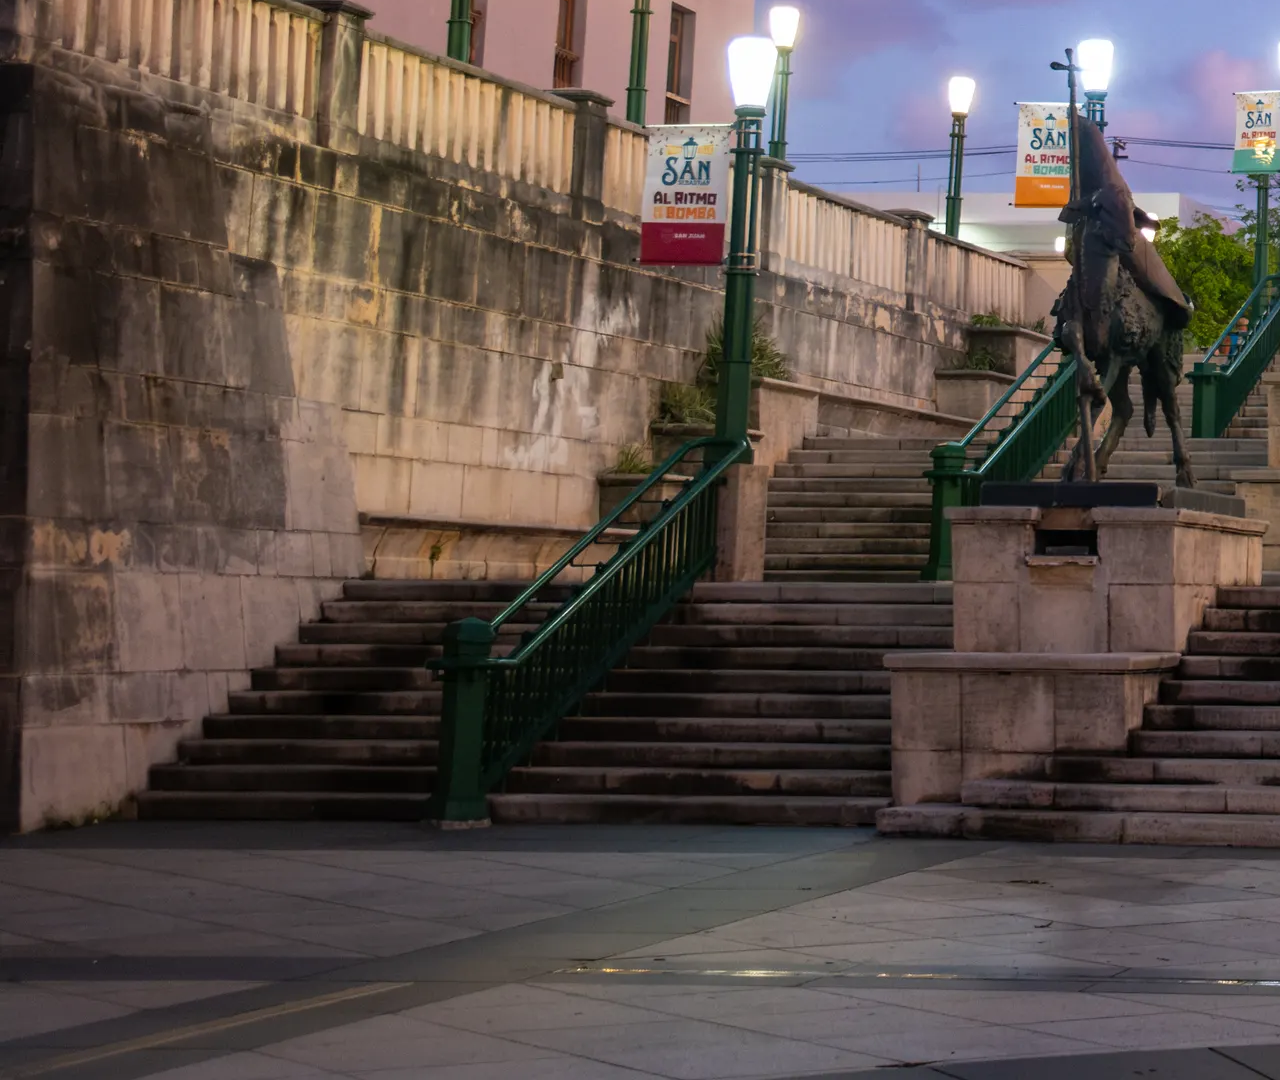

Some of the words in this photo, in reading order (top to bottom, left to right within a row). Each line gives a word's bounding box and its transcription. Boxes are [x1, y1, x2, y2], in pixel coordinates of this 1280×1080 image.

[1245, 111, 1272, 129] SAN
[1030, 127, 1066, 150] SAN
[1241, 131, 1250, 139] AL
[1252, 131, 1276, 139] RITMO
[1024, 153, 1038, 164] AL
[662, 156, 711, 186] SAN
[653, 191, 671, 205] AL
[675, 191, 717, 206] RITMO
[666, 206, 716, 220] BOMBA
